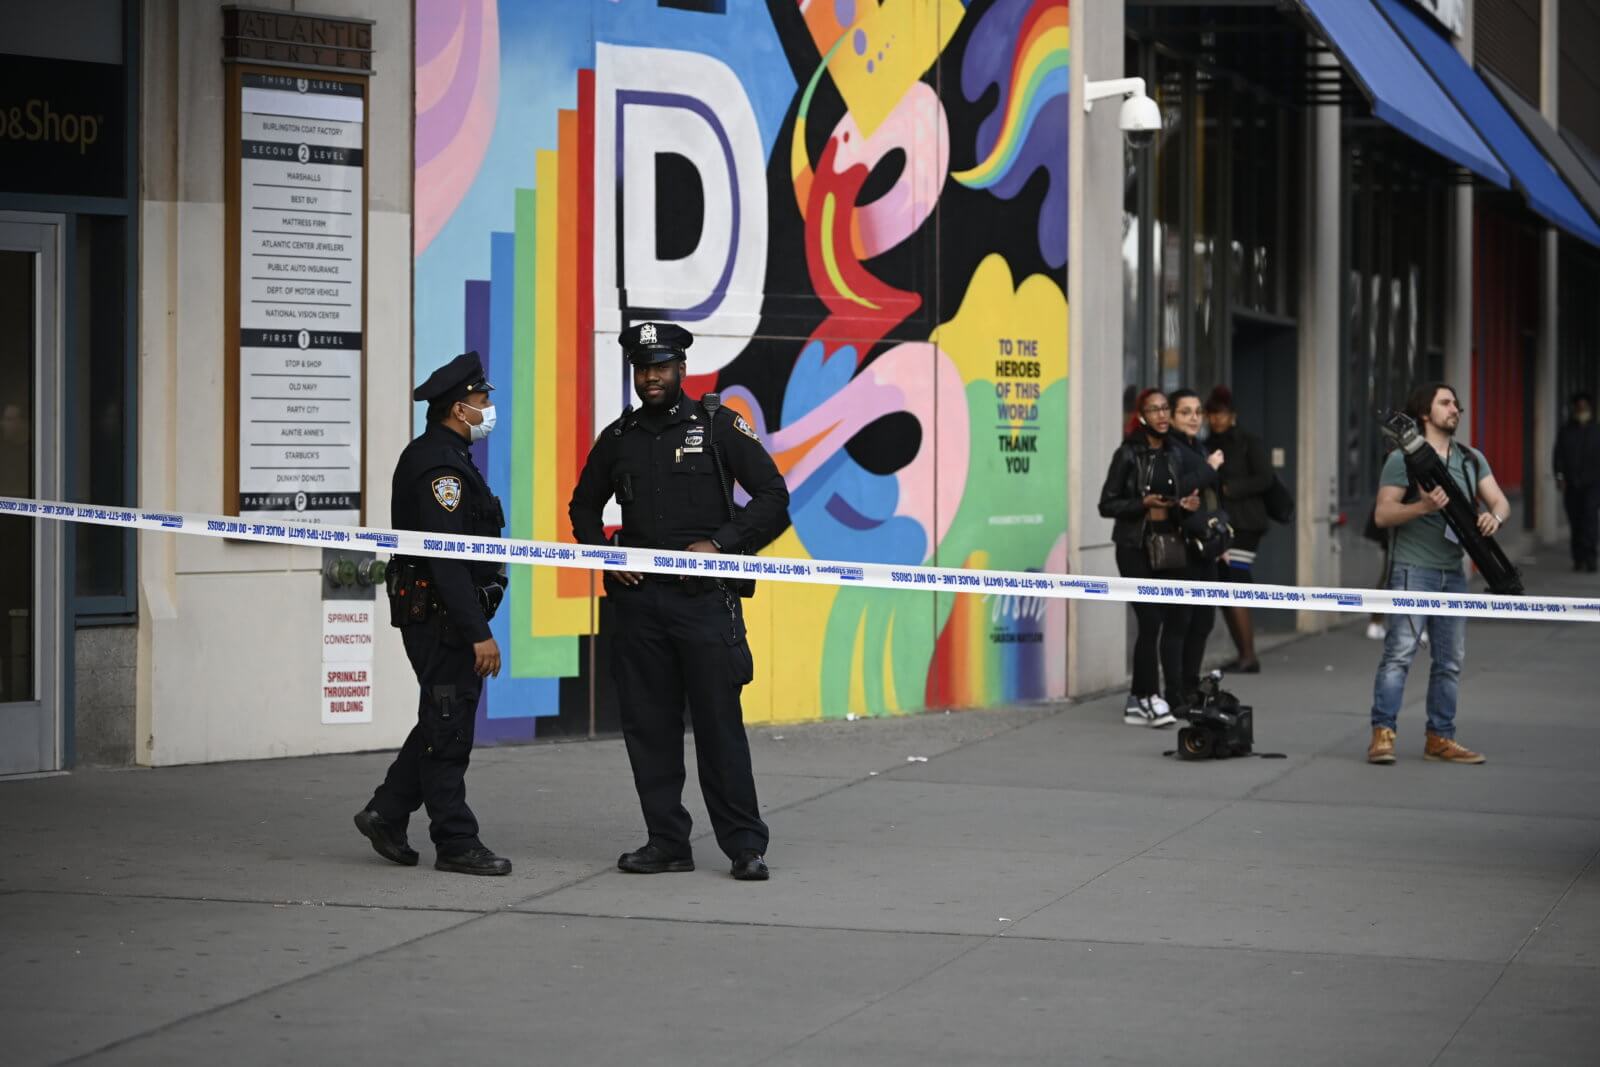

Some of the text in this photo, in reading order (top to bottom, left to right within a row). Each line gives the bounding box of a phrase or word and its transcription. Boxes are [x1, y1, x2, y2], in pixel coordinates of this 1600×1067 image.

[242, 13, 370, 48] ATLANTIC
[262, 76, 292, 86] THIRD
[312, 80, 343, 90] LEVEL
[262, 122, 343, 136] BURLINGTON COAT FACTORY
[252, 146, 294, 156] SECOND
[314, 152, 344, 160] LEVEL
[287, 172, 320, 182] MARSHALLS
[290, 196, 318, 205] BEST BUY
[282, 218, 326, 228] MATTRESS FIRM
[262, 240, 344, 252] ATLANTIC CENTER JEWELERS
[268, 263, 339, 274] PUBLIC AUTO INSURANCE
[266, 286, 339, 297] DEPT. OF MOTOR VEHICLE
[265, 310, 339, 320] NATIONAL VISION CENTER
[262, 334, 292, 342] FIRST
[314, 336, 344, 344] LEVEL
[999, 338, 1038, 356] TO THE
[996, 360, 1040, 378] HEROES
[996, 383, 1040, 399] OF THIS
[998, 404, 1038, 420] WORLD
[998, 435, 1037, 452] THANK
[1006, 456, 1030, 474] YOU
[245, 497, 290, 505] PARKING
[311, 497, 350, 505] GARAGE
[208, 520, 226, 531] CROSS
[226, 522, 238, 532] NOT
[239, 523, 246, 533] DO
[253, 525, 265, 534] LINE
[266, 526, 285, 536] POLICE
[424, 540, 442, 550] CROSS
[444, 541, 456, 551] NOT
[457, 542, 465, 552] DO
[472, 543, 485, 553] LINE
[486, 544, 506, 554] POLICE
[654, 556, 674, 567] CROSS
[675, 558, 687, 568] NOT
[688, 559, 696, 569] DO
[704, 560, 716, 570] LINE
[718, 561, 739, 571] POLICE
[892, 572, 912, 582] CROSS
[914, 573, 926, 583] NOT
[927, 574, 936, 583] DO
[944, 575, 956, 584] LINE
[958, 576, 980, 585] POLICE
[1138, 586, 1159, 595] CROSS
[1161, 587, 1173, 596] NOT
[1175, 588, 1184, 596] DO
[1192, 588, 1205, 597] LINE
[1206, 589, 1229, 598] POLICE
[1393, 598, 1415, 607] CROSS
[1416, 599, 1429, 608] NOT
[1431, 600, 1440, 608] DO
[1448, 600, 1462, 608] LINE
[1463, 601, 1487, 609] POLICE
[328, 613, 368, 623] SPRINKLER
[324, 634, 372, 644] CONNECTION
[328, 672, 367, 682] SPRINKLER
[324, 686, 370, 698] THROUGHOUT
[330, 701, 363, 712] BUILDING
